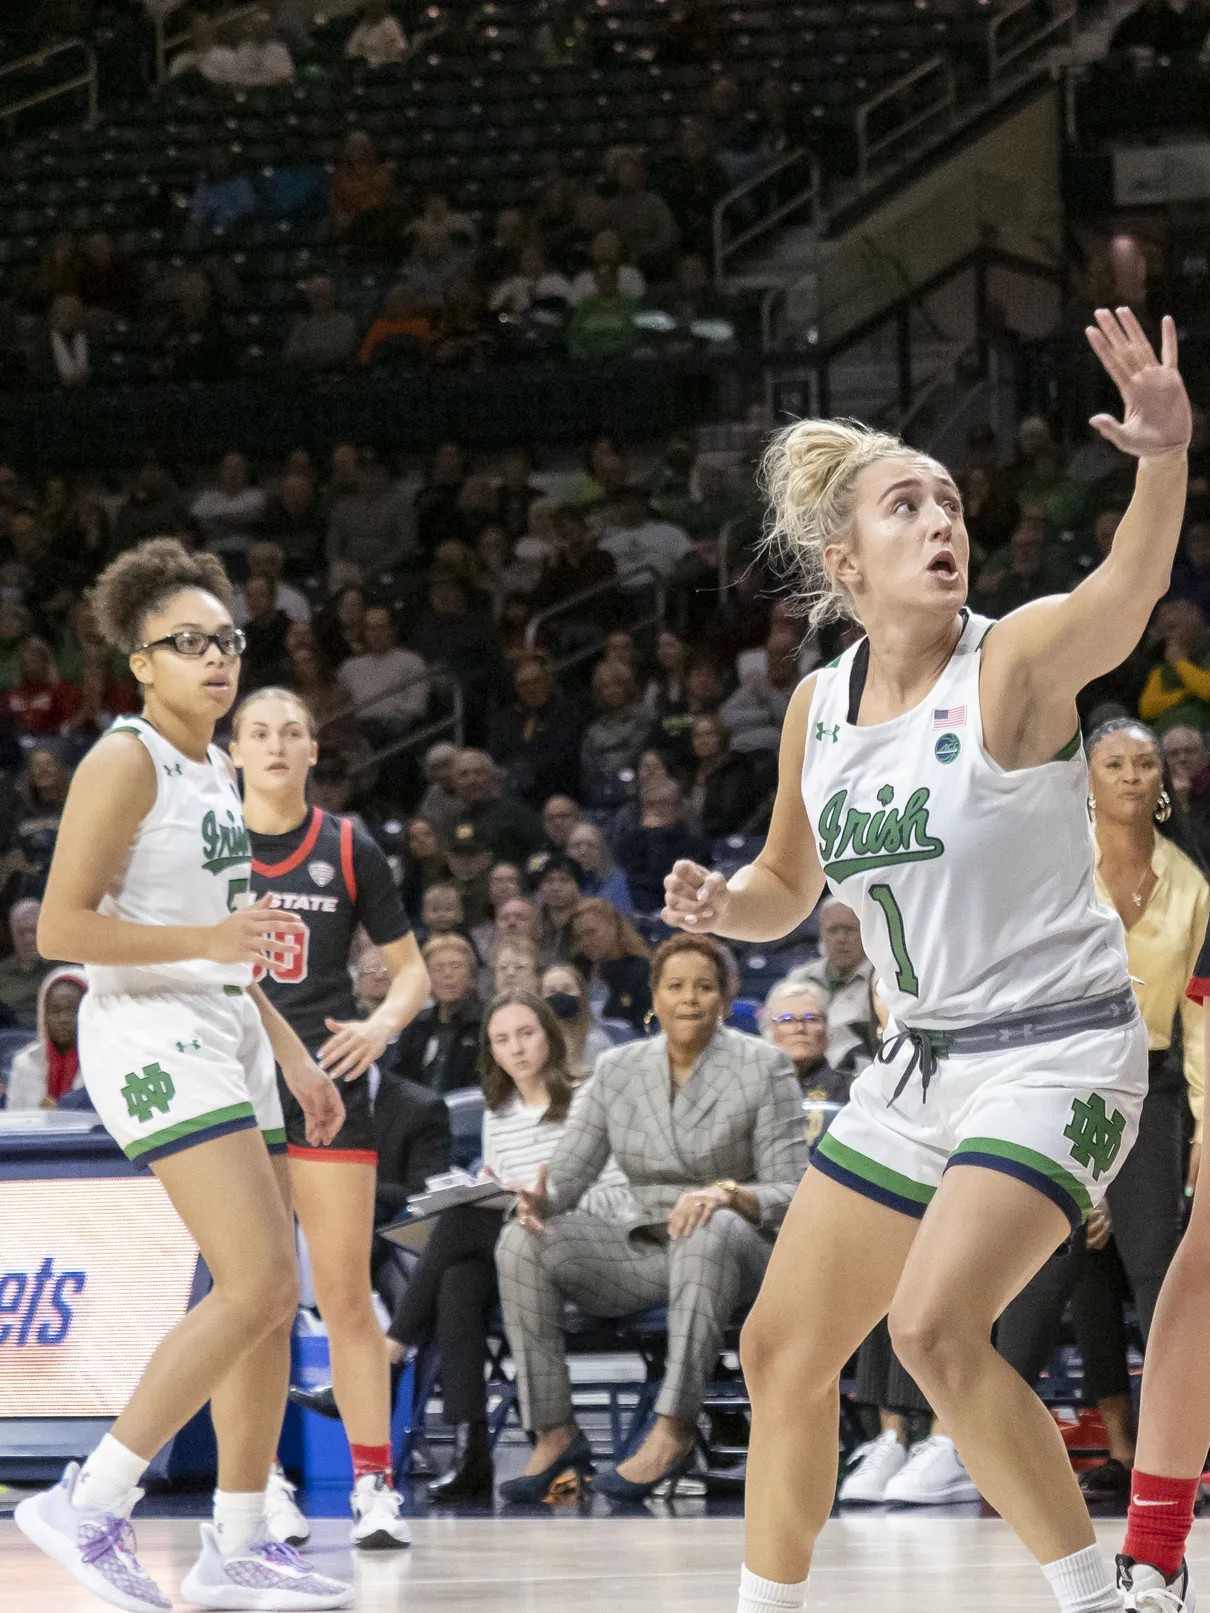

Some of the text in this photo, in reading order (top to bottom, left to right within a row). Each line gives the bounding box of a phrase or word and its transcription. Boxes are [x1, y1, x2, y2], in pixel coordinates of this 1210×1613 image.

[818, 784, 945, 880] Irish
[268, 893, 339, 913] STATE
[868, 884, 920, 999] 1
